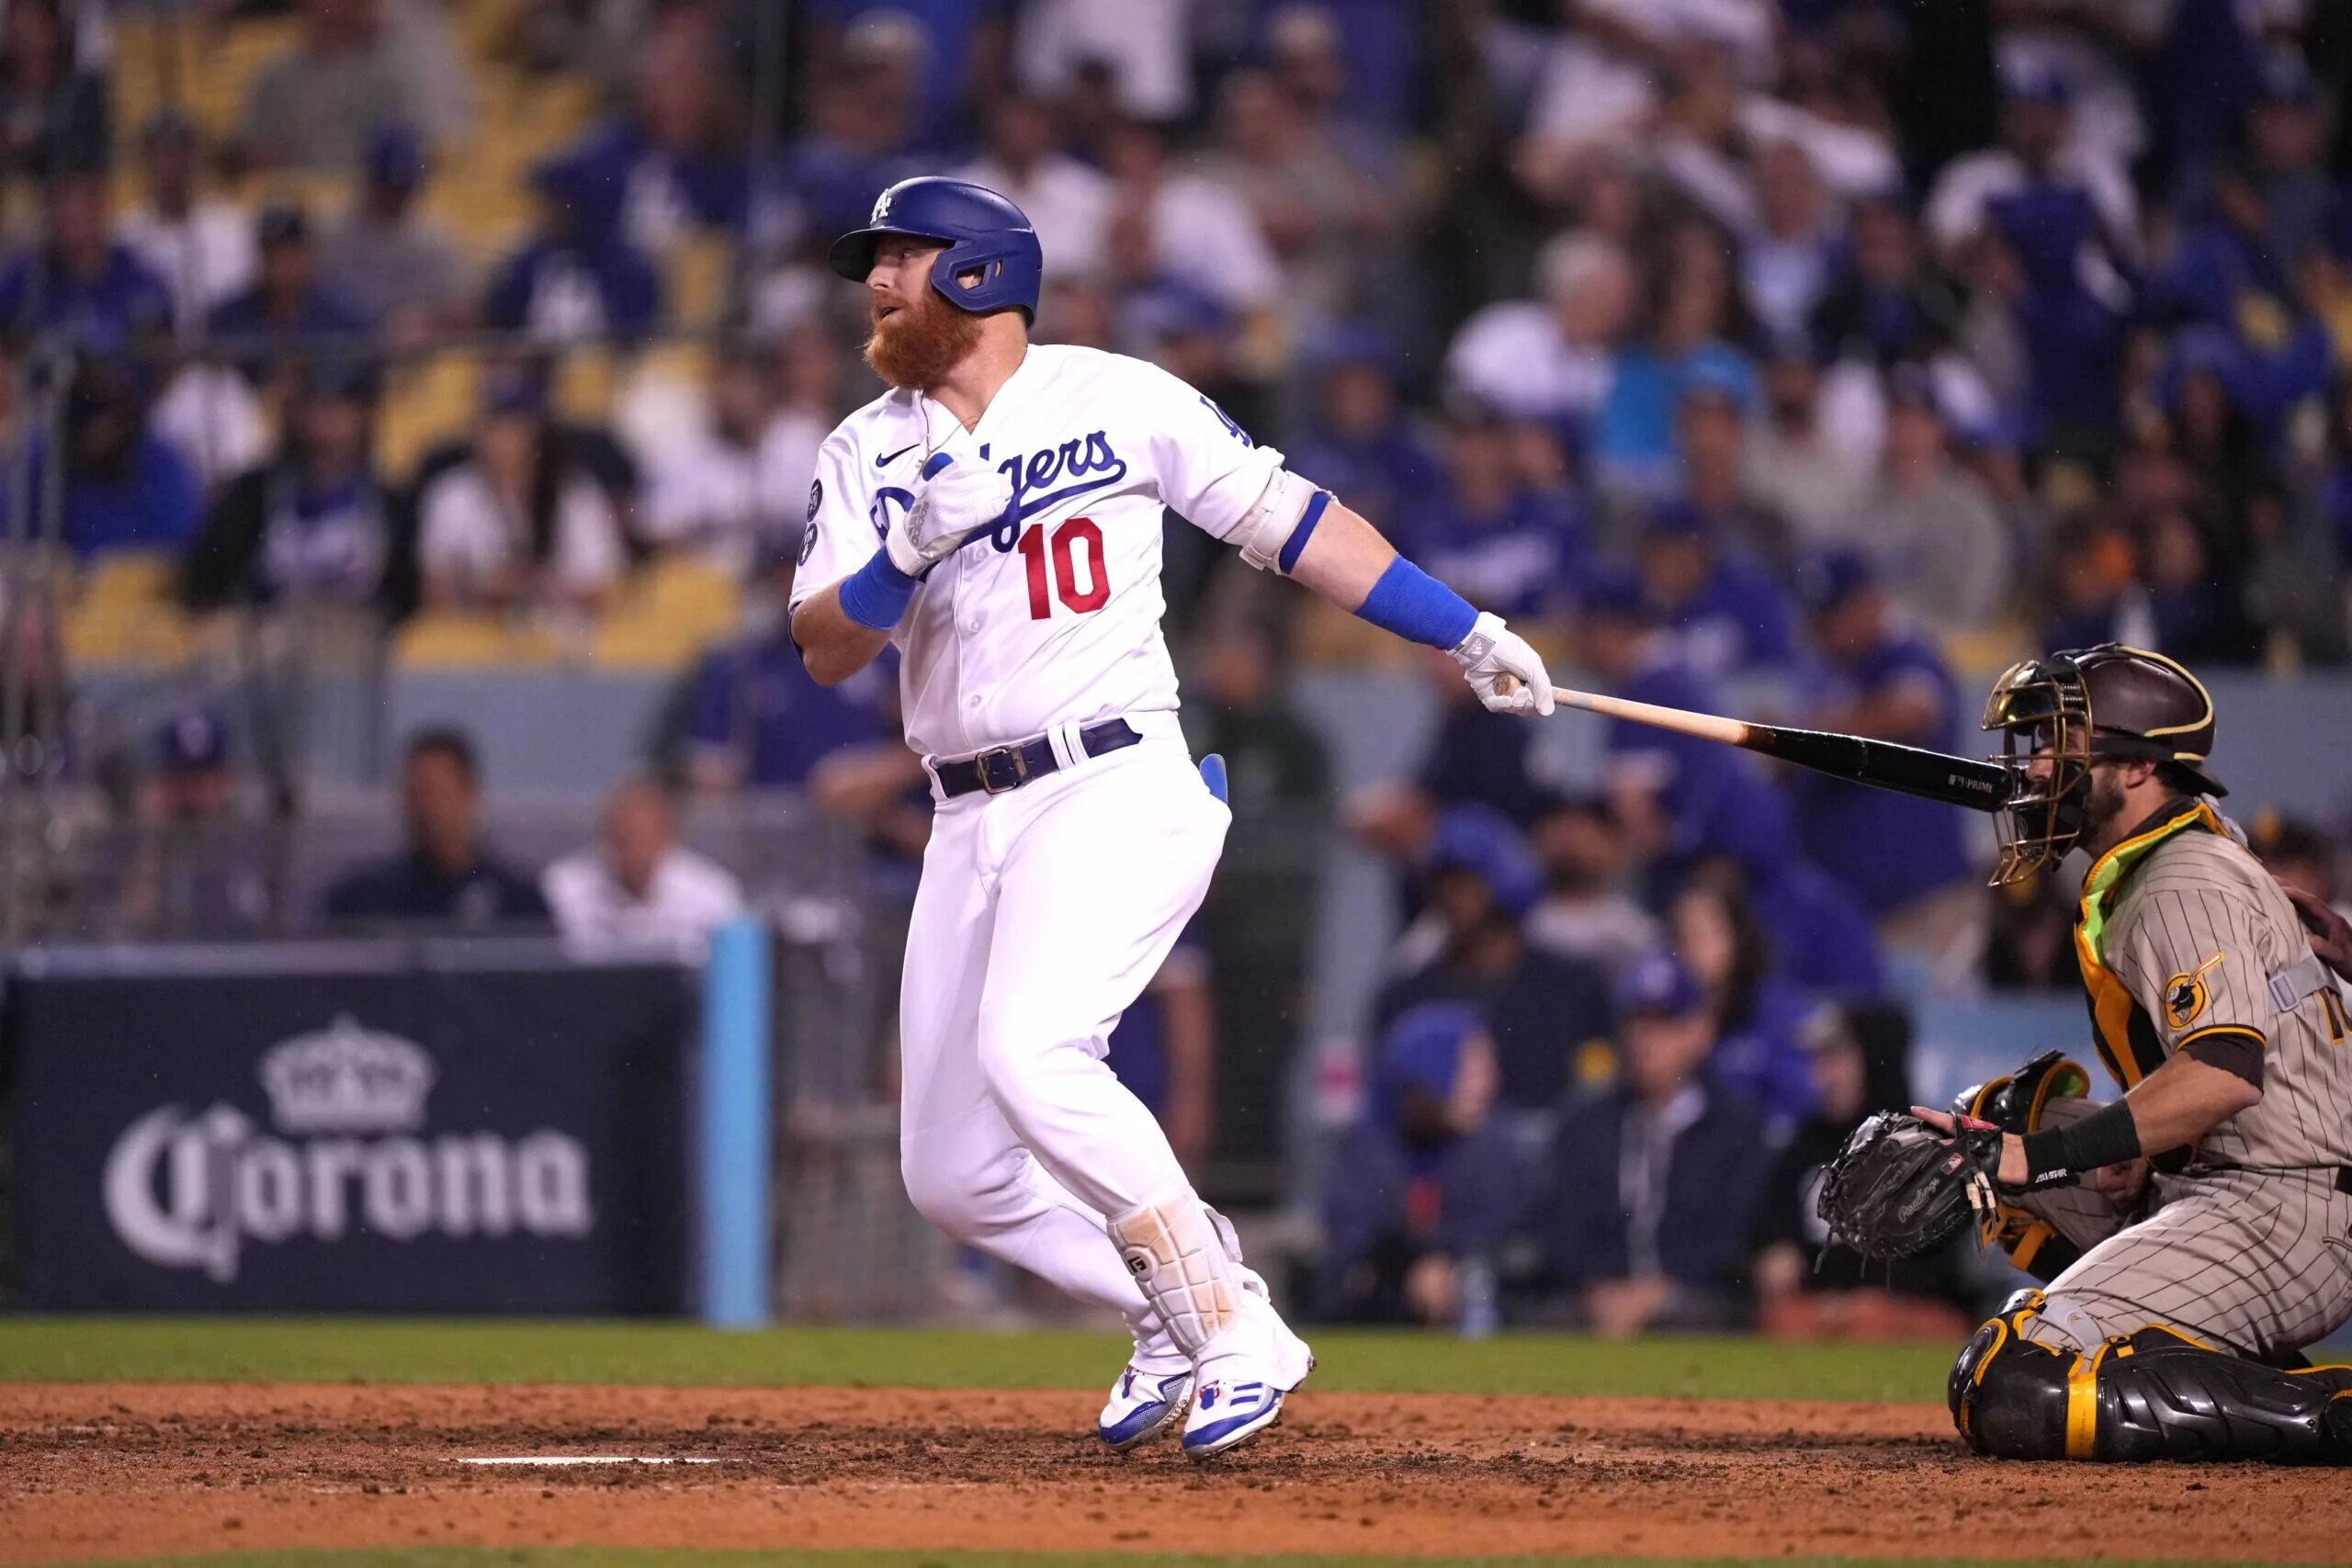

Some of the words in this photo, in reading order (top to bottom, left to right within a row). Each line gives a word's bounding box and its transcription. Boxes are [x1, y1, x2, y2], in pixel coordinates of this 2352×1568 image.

[1017, 516, 1112, 621] 10
[1967, 777, 1996, 794] PRIME
[103, 1104, 595, 1283] Corona
[1897, 1177, 1940, 1224] Rawlings
